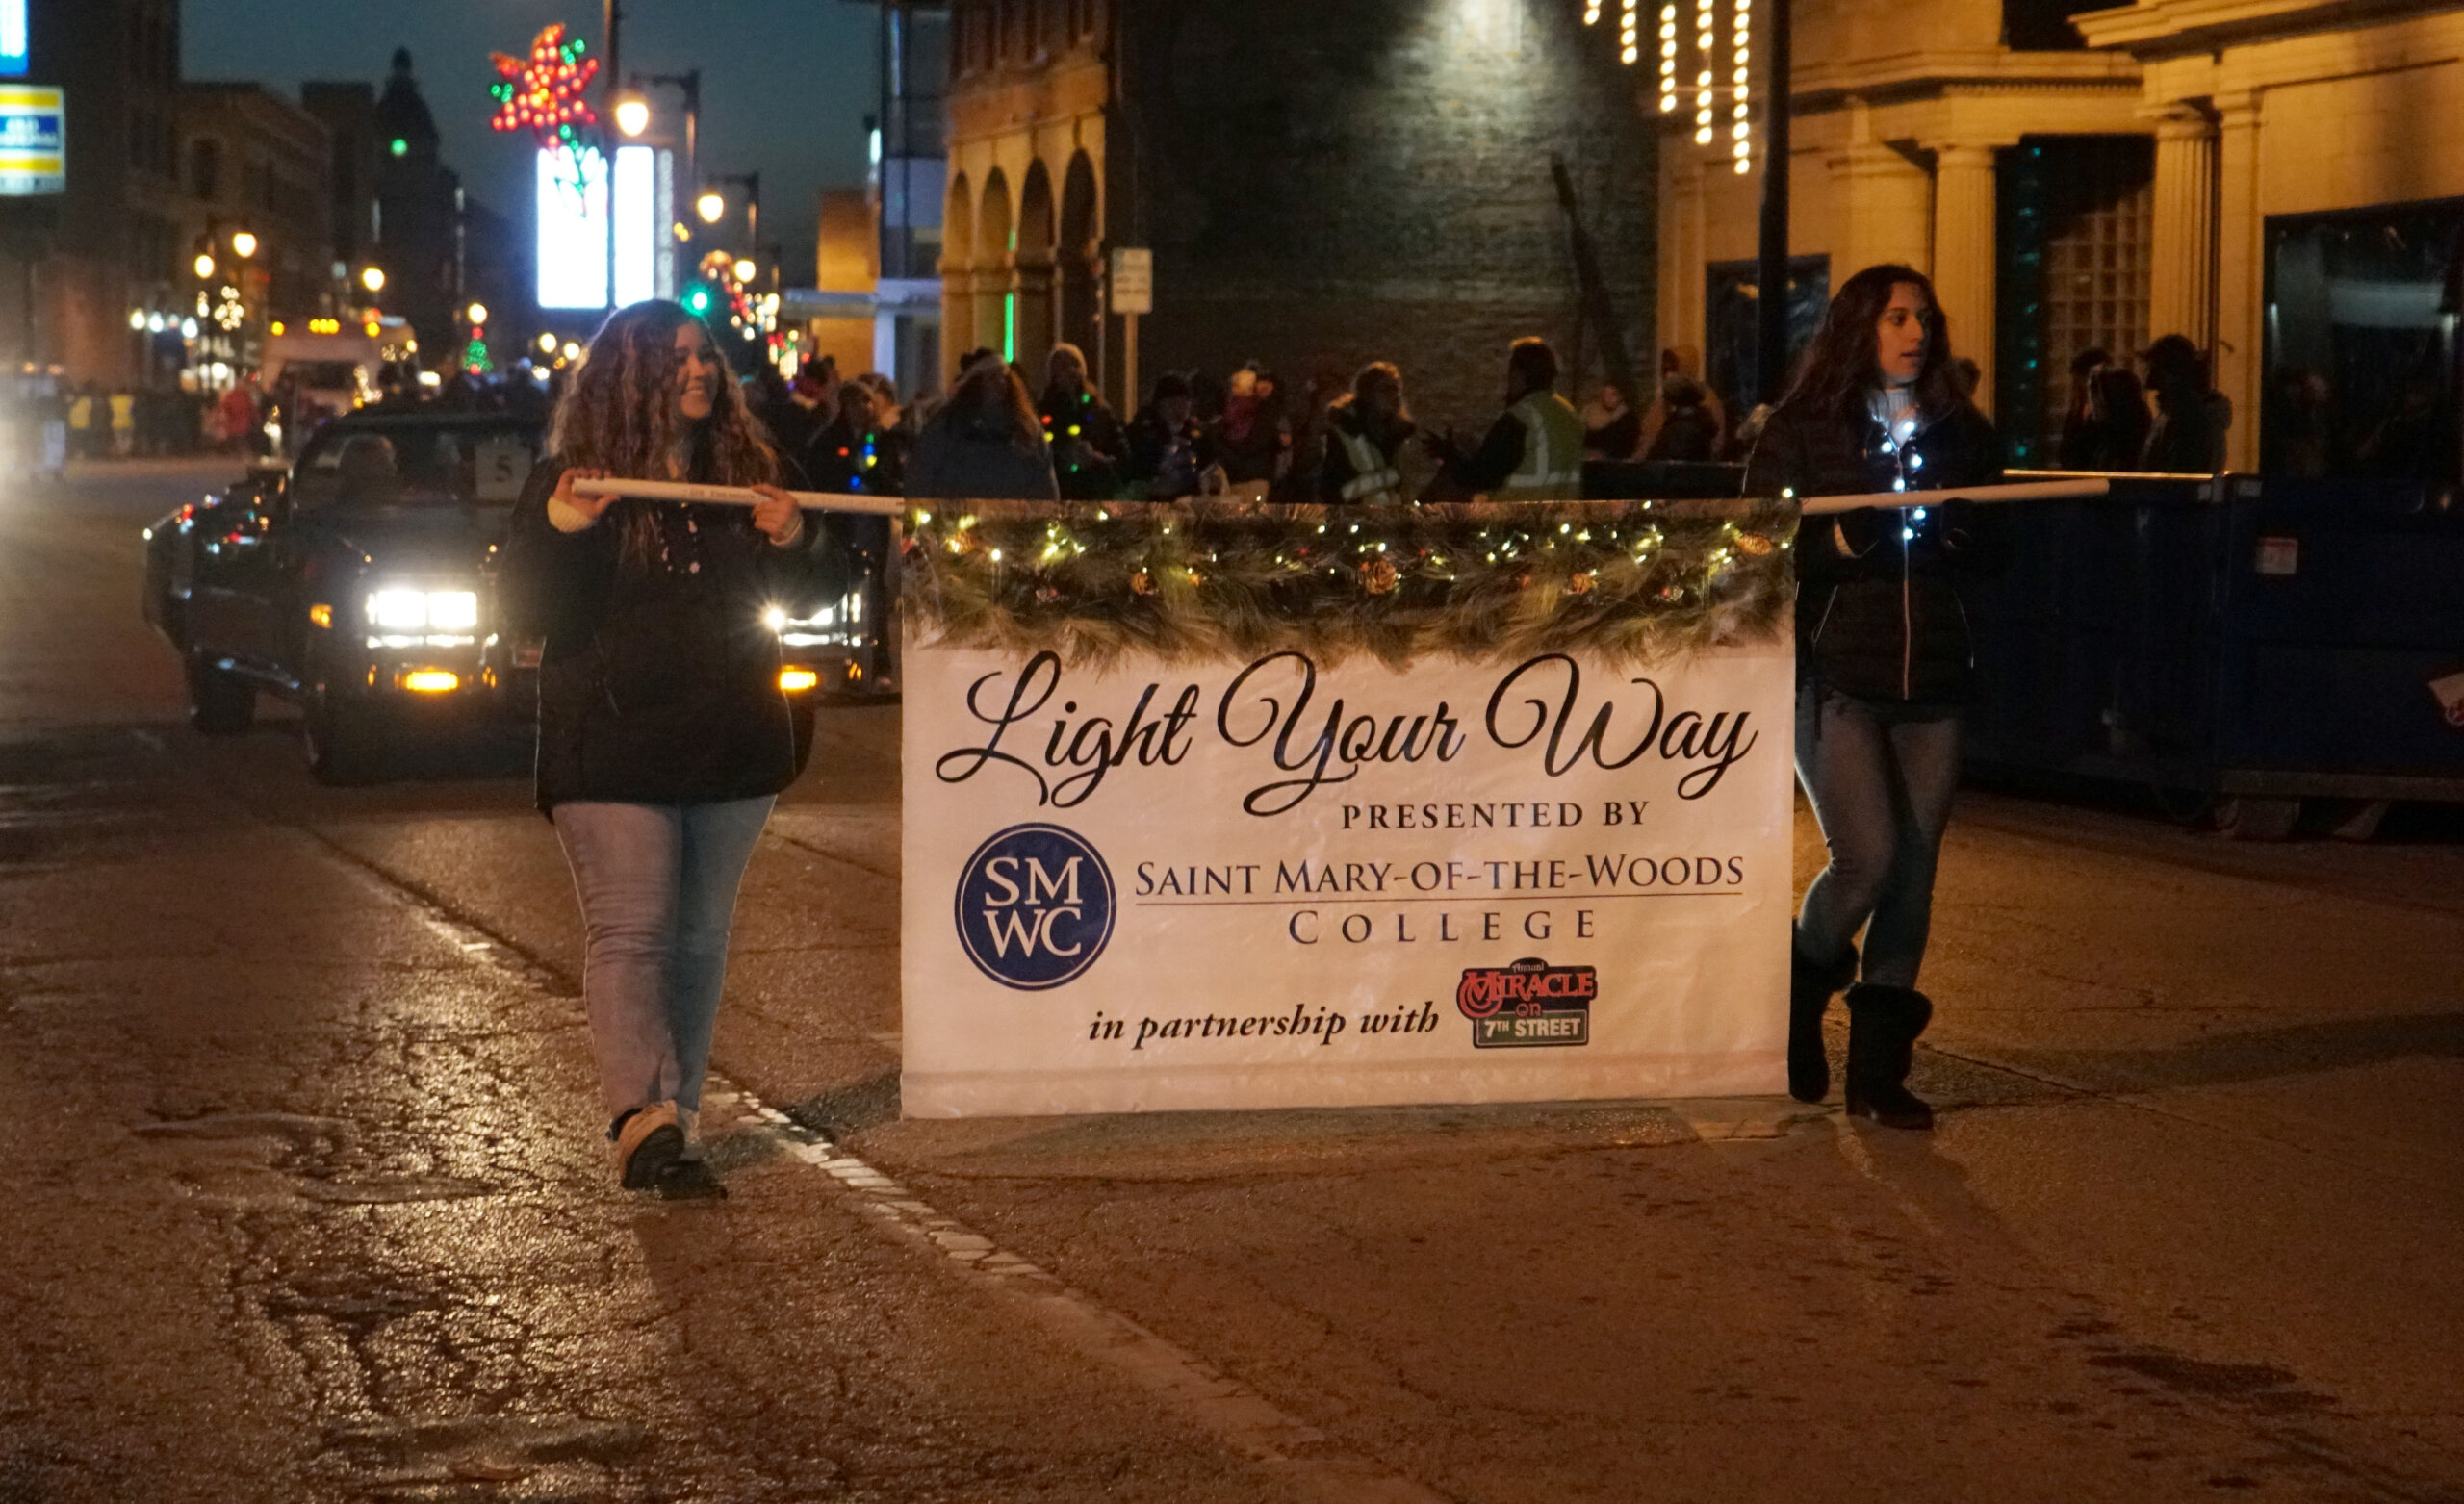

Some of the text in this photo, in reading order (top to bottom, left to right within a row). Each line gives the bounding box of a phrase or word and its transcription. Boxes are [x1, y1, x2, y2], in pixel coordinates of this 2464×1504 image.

[936, 650, 1758, 816] Light Your Way
[1342, 801, 1650, 830] PRESENTED BY
[985, 855, 1083, 906] SM
[1135, 861, 1261, 896] SAINT
[983, 906, 1081, 959] WC
[1289, 909, 1595, 944] COLLEGE
[1459, 971, 1594, 1015] MIRACLE
[1516, 1002, 1542, 1017] on
[1089, 1001, 1439, 1051] in partnership with
[1484, 1017, 1581, 1038] 7TH STREET
